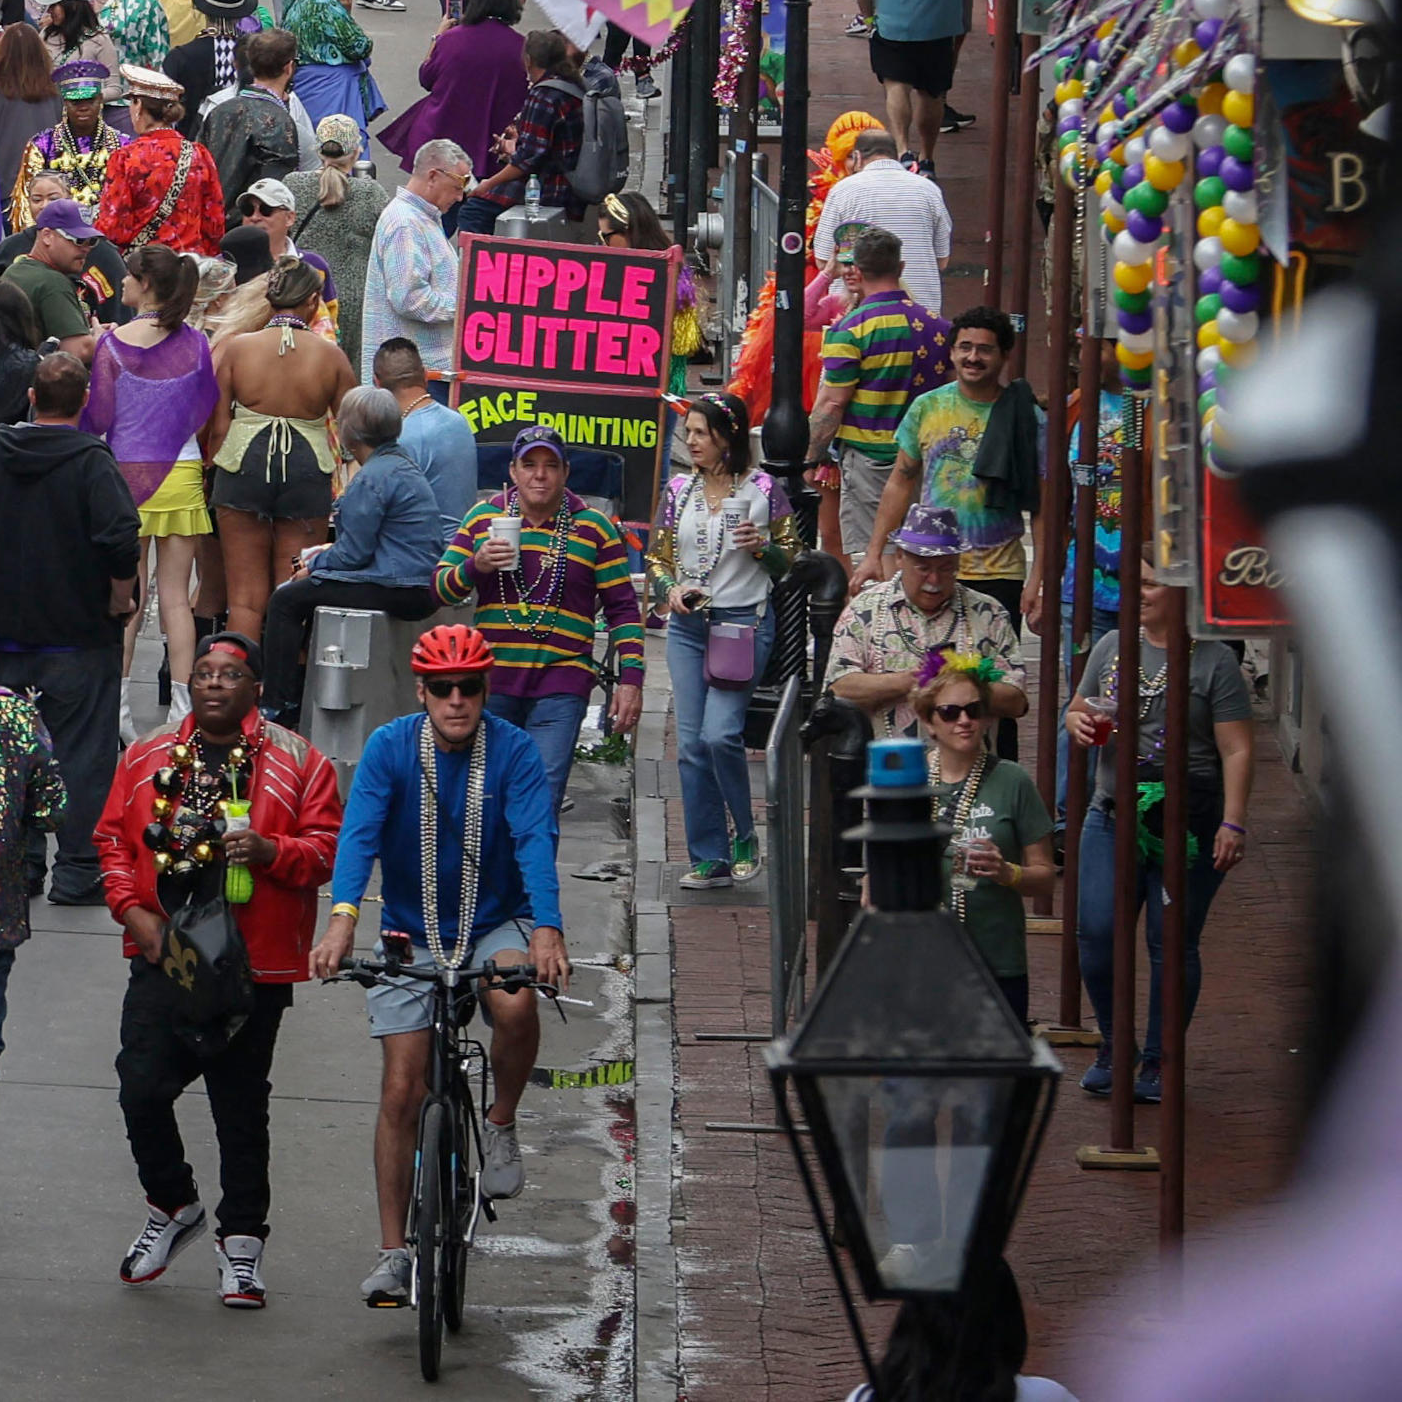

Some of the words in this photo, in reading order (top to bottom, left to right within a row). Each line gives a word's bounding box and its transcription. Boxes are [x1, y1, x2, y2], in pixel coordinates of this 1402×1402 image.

[473, 250, 656, 319] NIPPLE
[463, 311, 661, 378] GLITTER
[458, 391, 538, 435] FACE
[538, 412, 657, 448] PAINTING
